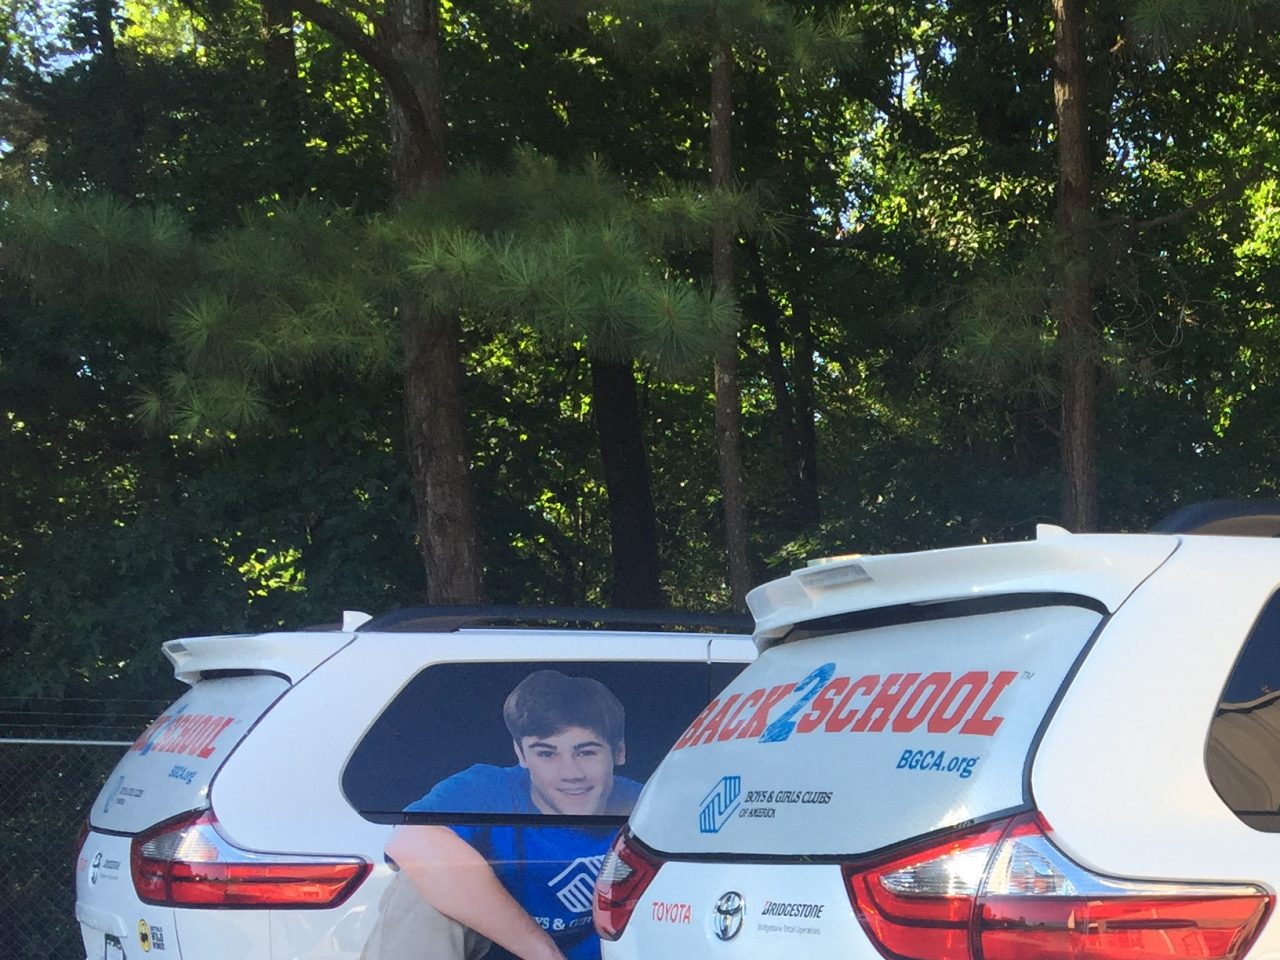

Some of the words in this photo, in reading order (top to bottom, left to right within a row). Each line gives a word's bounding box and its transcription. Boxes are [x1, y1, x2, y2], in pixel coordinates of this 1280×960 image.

[896, 749, 980, 779] BGCA.org
[744, 791, 769, 803] BOYS
[767, 791, 774, 803] &
[775, 791, 802, 804] GIRLS
[801, 791, 833, 804] CLUBS
[738, 808, 749, 818] OF
[652, 902, 692, 924] TOYOTA
[761, 901, 825, 919] BRIDGESTONE
[553, 918, 566, 930] &
